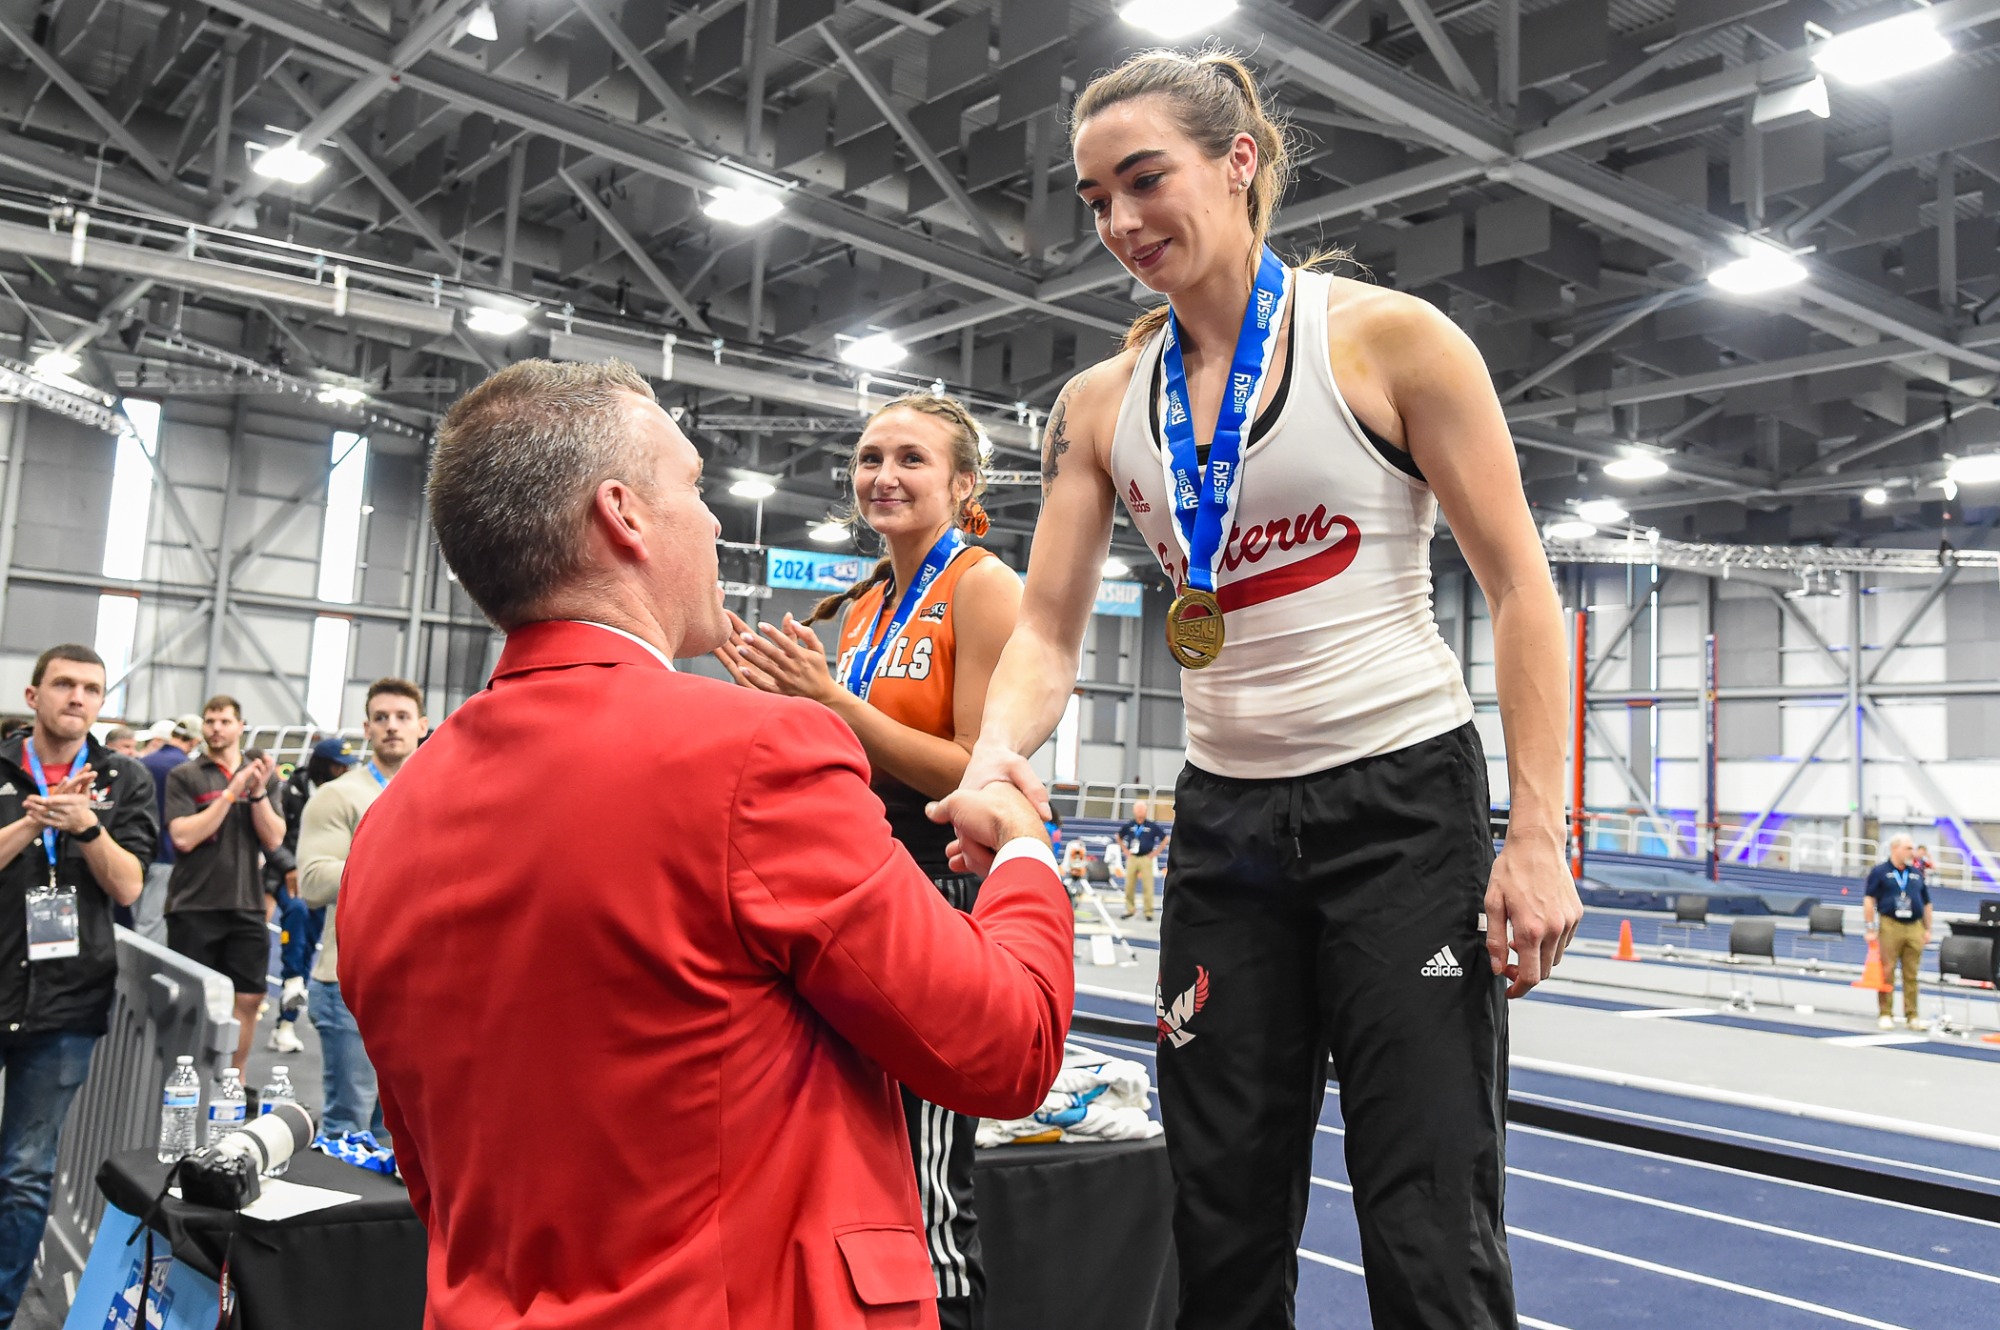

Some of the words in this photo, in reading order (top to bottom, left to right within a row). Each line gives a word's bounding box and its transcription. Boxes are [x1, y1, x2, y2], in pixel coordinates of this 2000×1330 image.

[1157, 503, 1338, 598] Etern
[773, 559, 814, 581] 2024
[1420, 964, 1464, 977] adidas
